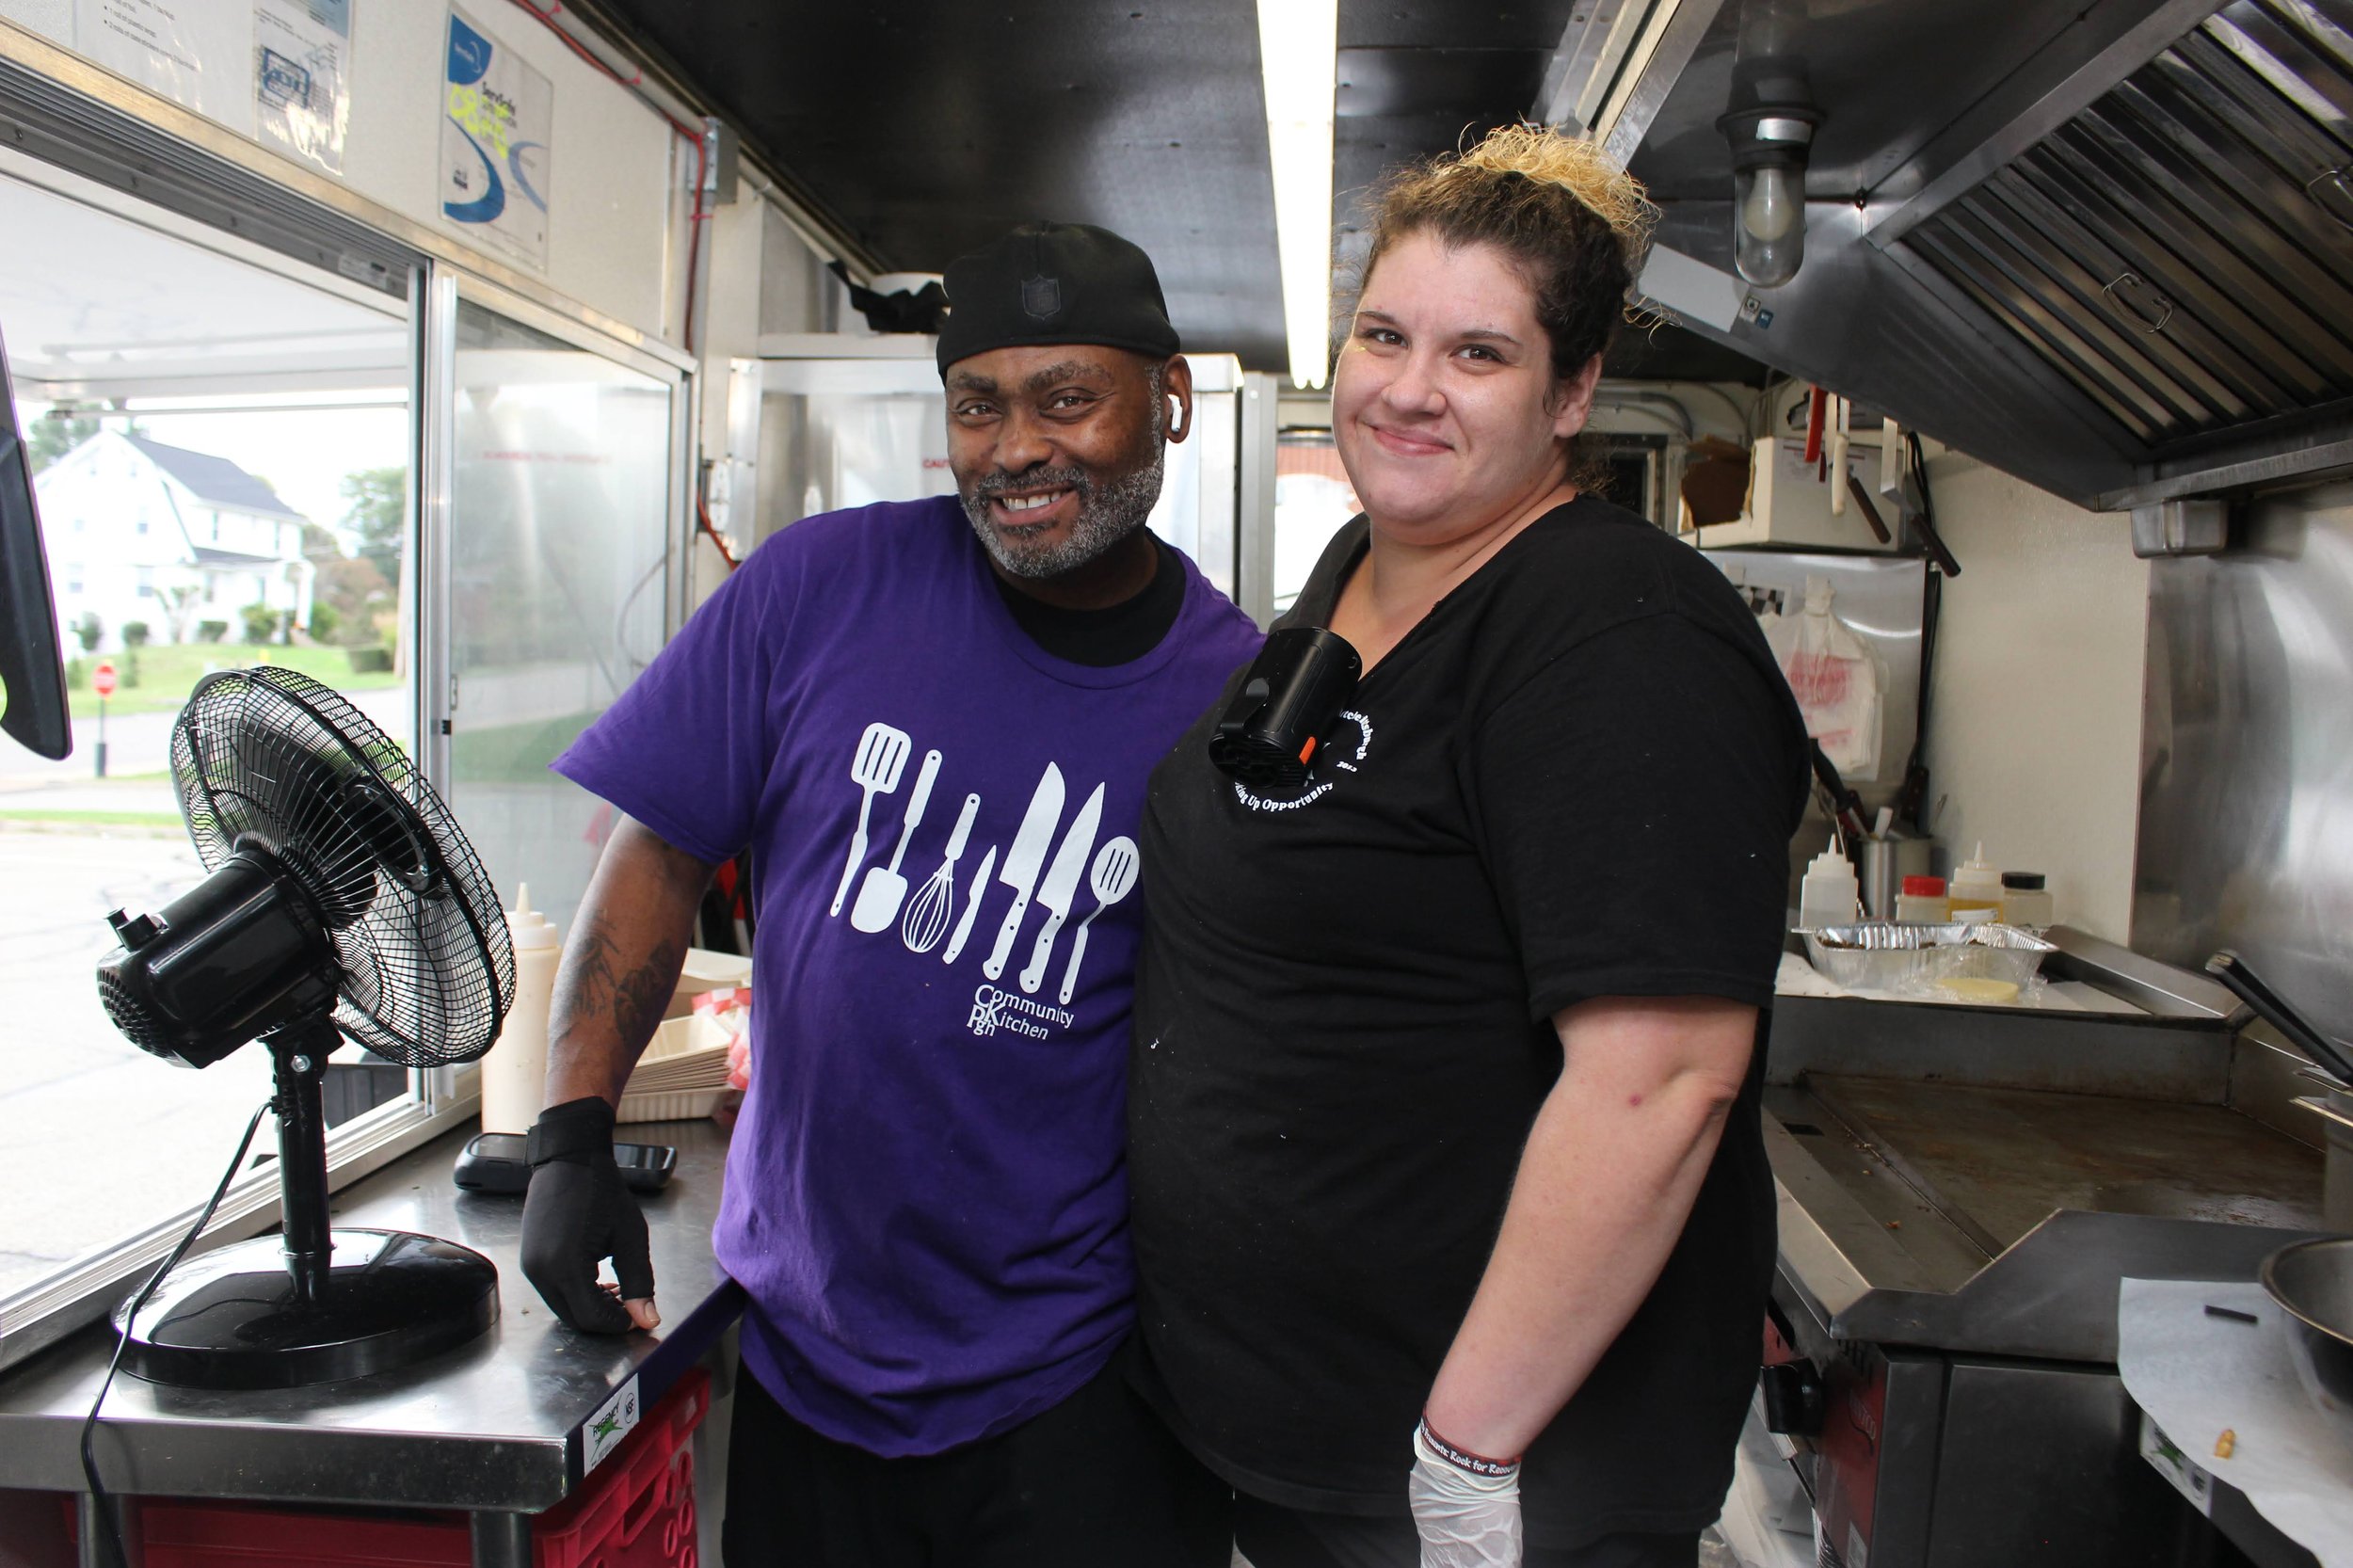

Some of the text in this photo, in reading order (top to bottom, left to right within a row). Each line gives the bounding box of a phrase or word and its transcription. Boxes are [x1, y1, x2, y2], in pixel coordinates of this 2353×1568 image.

[1247, 794, 1261, 811] Up
[1262, 782, 1334, 812] Opportunity
[974, 984, 1075, 1029] Community
[984, 999, 1049, 1040] Kitchen
[592, 1400, 620, 1437] REGENCY
[1449, 1449, 1472, 1468] Rock
[1472, 1460, 1489, 1473] for
